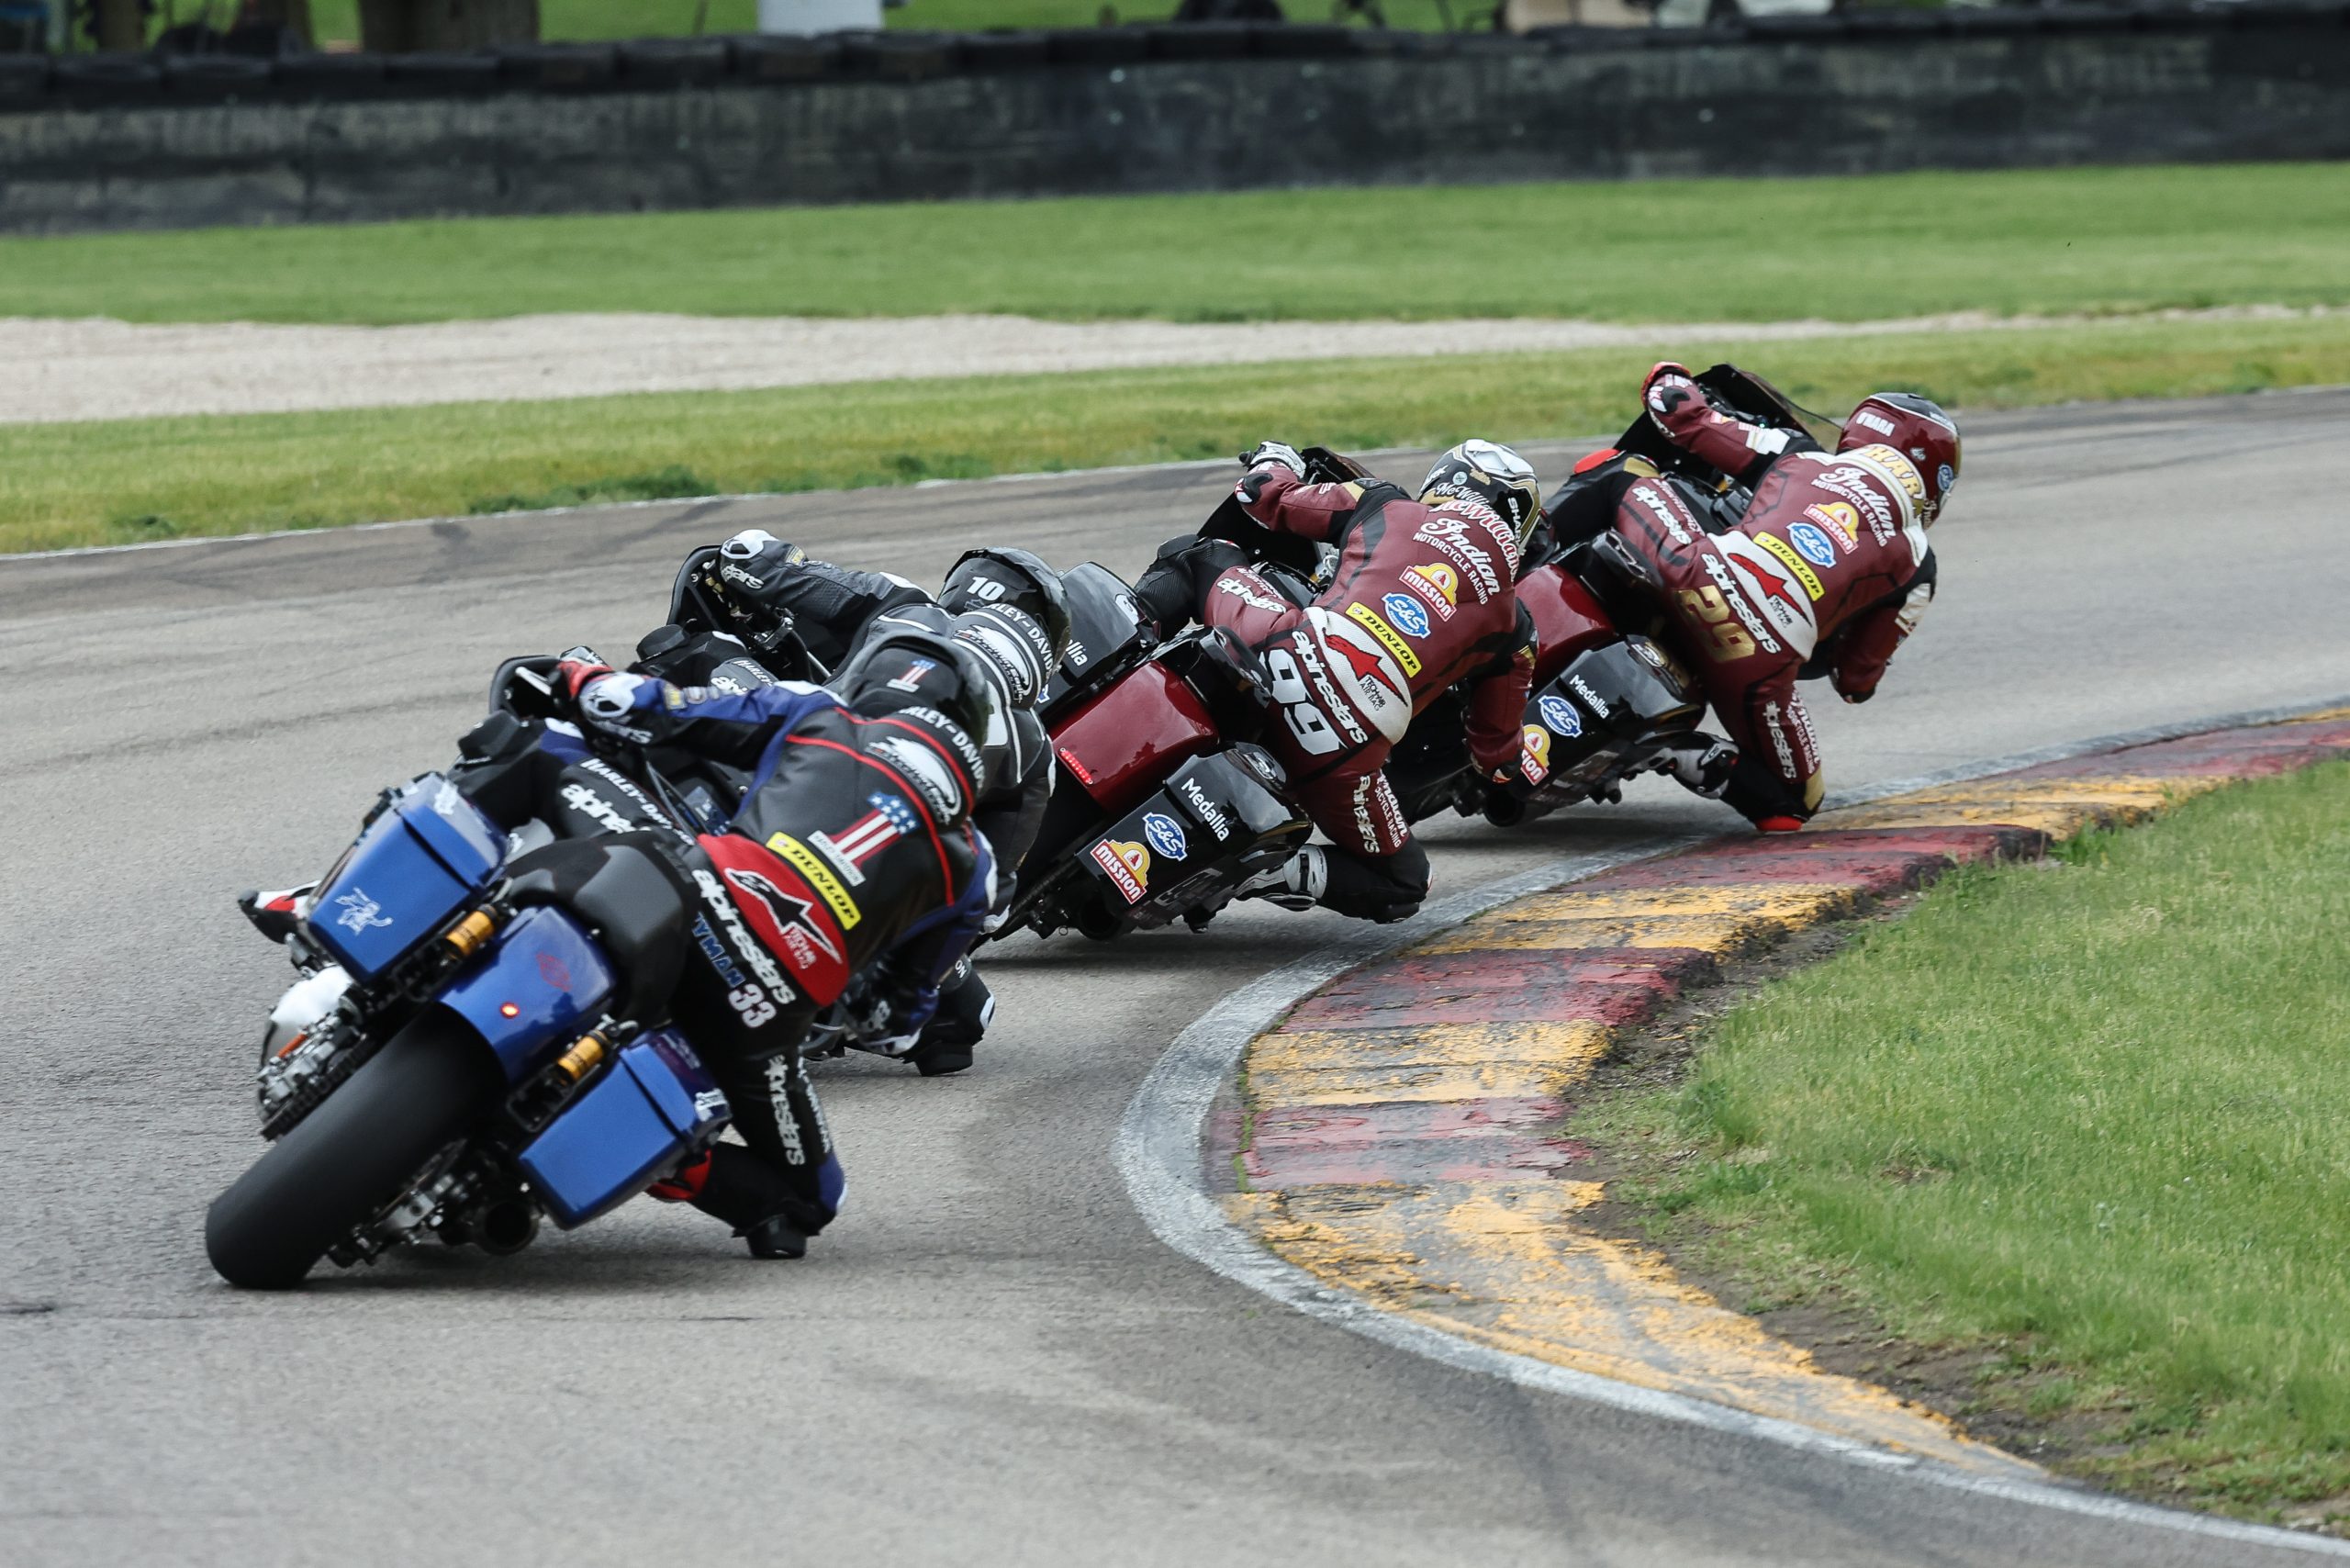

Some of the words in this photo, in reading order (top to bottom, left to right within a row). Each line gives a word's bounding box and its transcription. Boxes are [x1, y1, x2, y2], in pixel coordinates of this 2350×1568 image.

[1810, 478, 1871, 514] MOTORCYCLE
[1865, 512, 1888, 547] RACING
[1818, 466, 1897, 538] Indian
[1412, 532, 1470, 573] MOTORCYCLE
[1468, 572, 1489, 605] RACING
[1421, 517, 1501, 595] Indian
[1772, 543, 1820, 593] DUNLOP
[1792, 528, 1831, 559] S&S
[967, 576, 1006, 601] 10
[1388, 599, 1426, 630] S&S
[1701, 553, 1782, 654] alpinestars
[1364, 615, 1417, 669] DUNLOP
[1678, 585, 1756, 663] 29
[1259, 648, 1349, 756] 99
[1292, 631, 1369, 744] alpinestars
[1545, 700, 1577, 731] S&S
[1570, 674, 1610, 720] Medallia
[1521, 749, 1544, 780] sion
[1147, 819, 1184, 852] S&S
[1181, 777, 1230, 842] Medallia
[1387, 819, 1402, 848] RACING
[791, 849, 855, 920] DUNLOP
[691, 869, 797, 1004] alpinestars
[692, 911, 746, 989] YMAN
[728, 983, 778, 1028] 33
